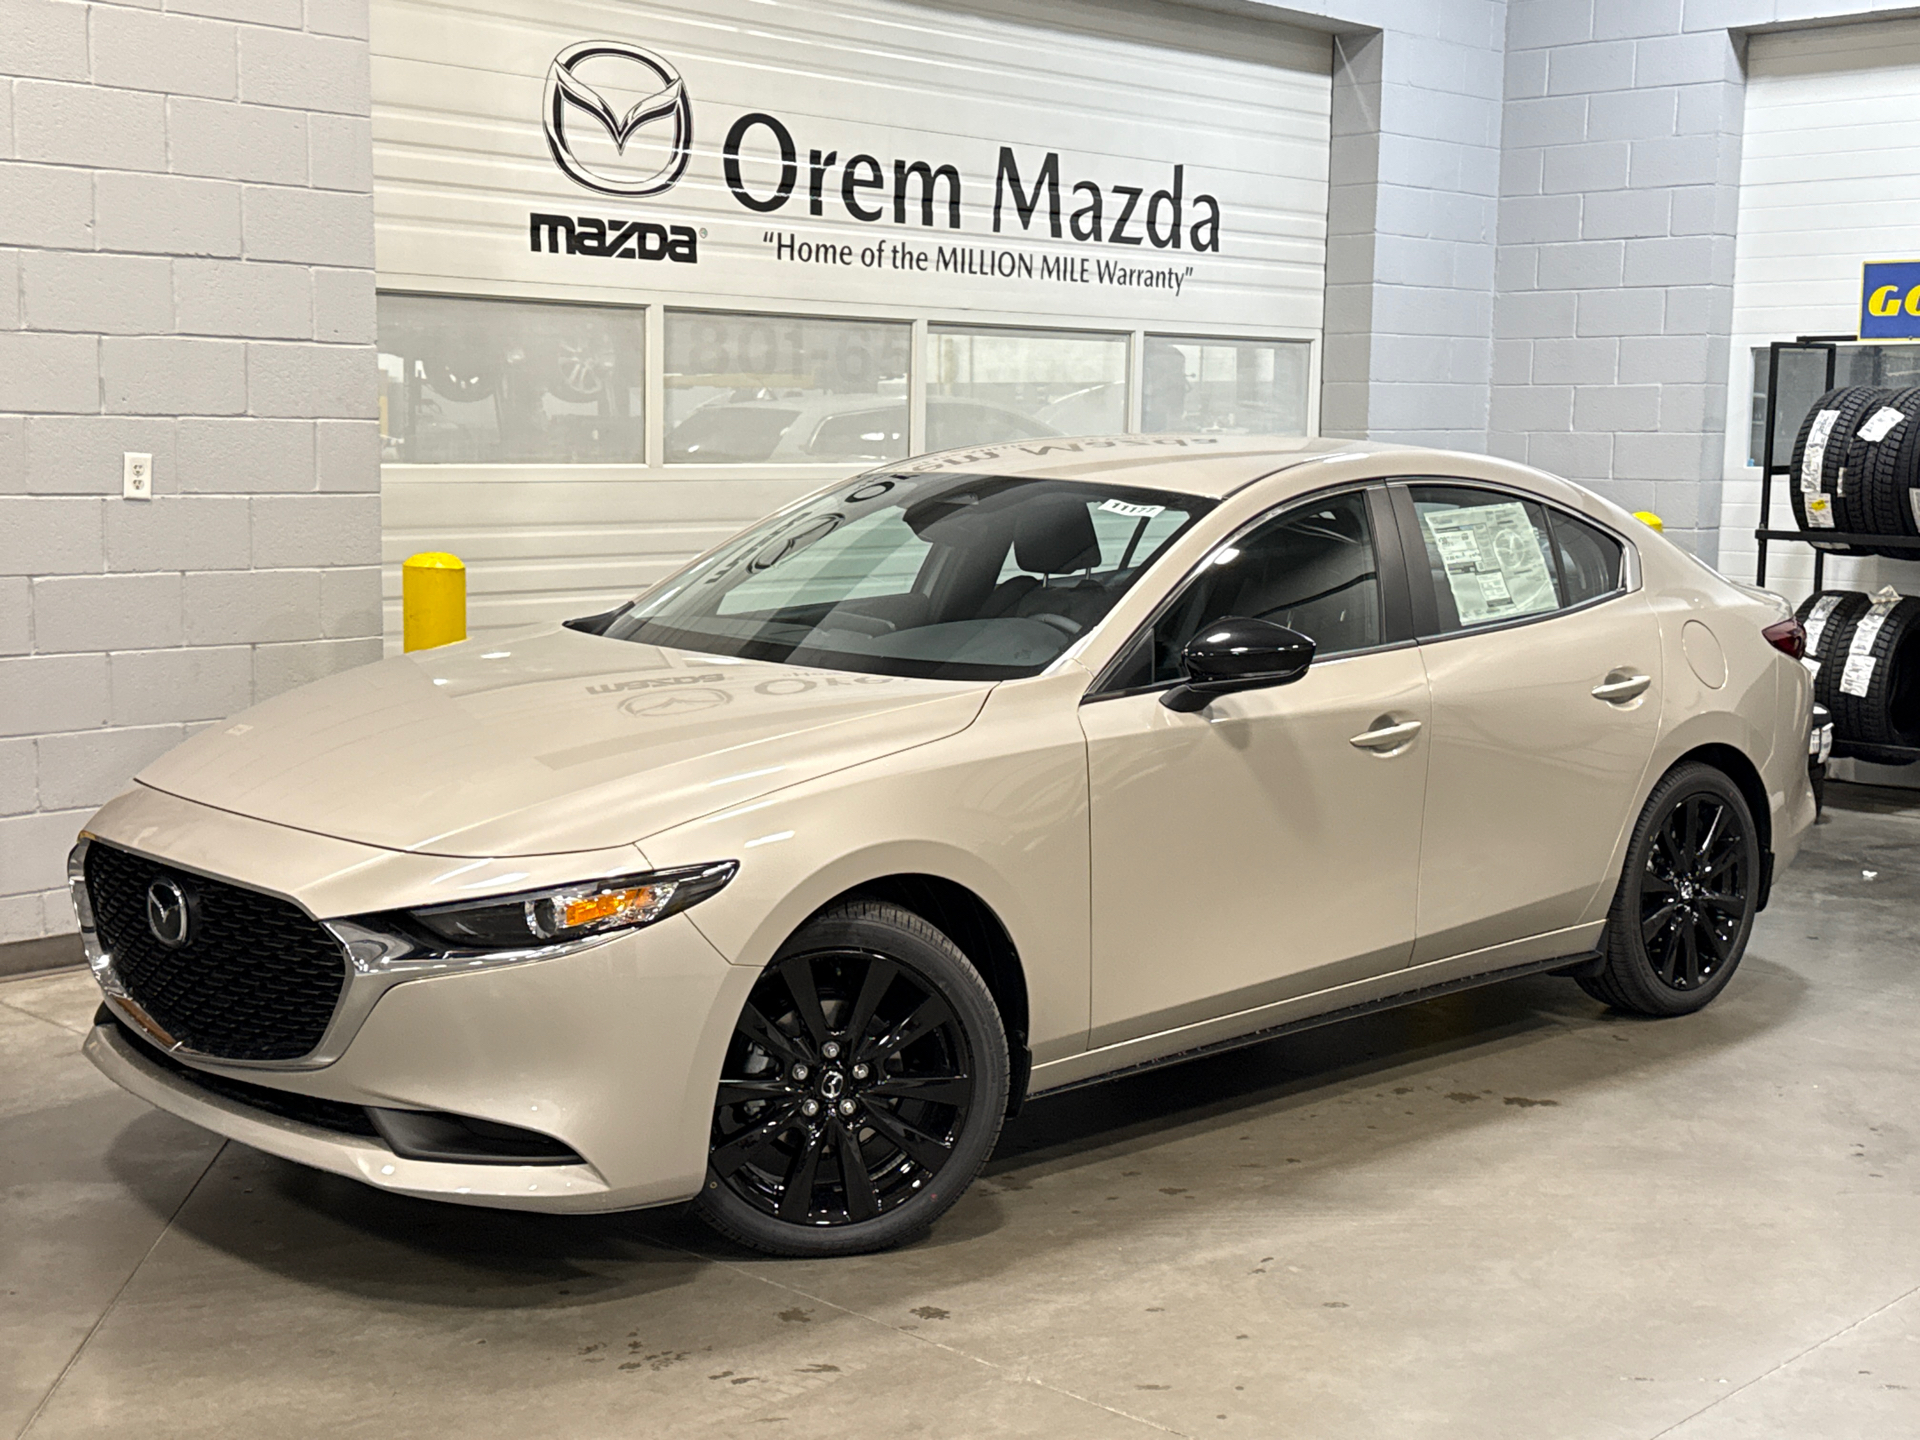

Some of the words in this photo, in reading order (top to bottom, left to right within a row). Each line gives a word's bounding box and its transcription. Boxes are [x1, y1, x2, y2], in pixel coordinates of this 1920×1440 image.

[722, 112, 962, 230] Orem
[991, 146, 1222, 253] Mazda
[530, 212, 698, 264] mazda
[763, 231, 853, 266] “Home
[861, 239, 886, 268] of
[891, 242, 928, 271] the
[936, 246, 1033, 279] MILLION
[1040, 255, 1089, 283] MILE
[1096, 259, 1193, 297] Warranty”
